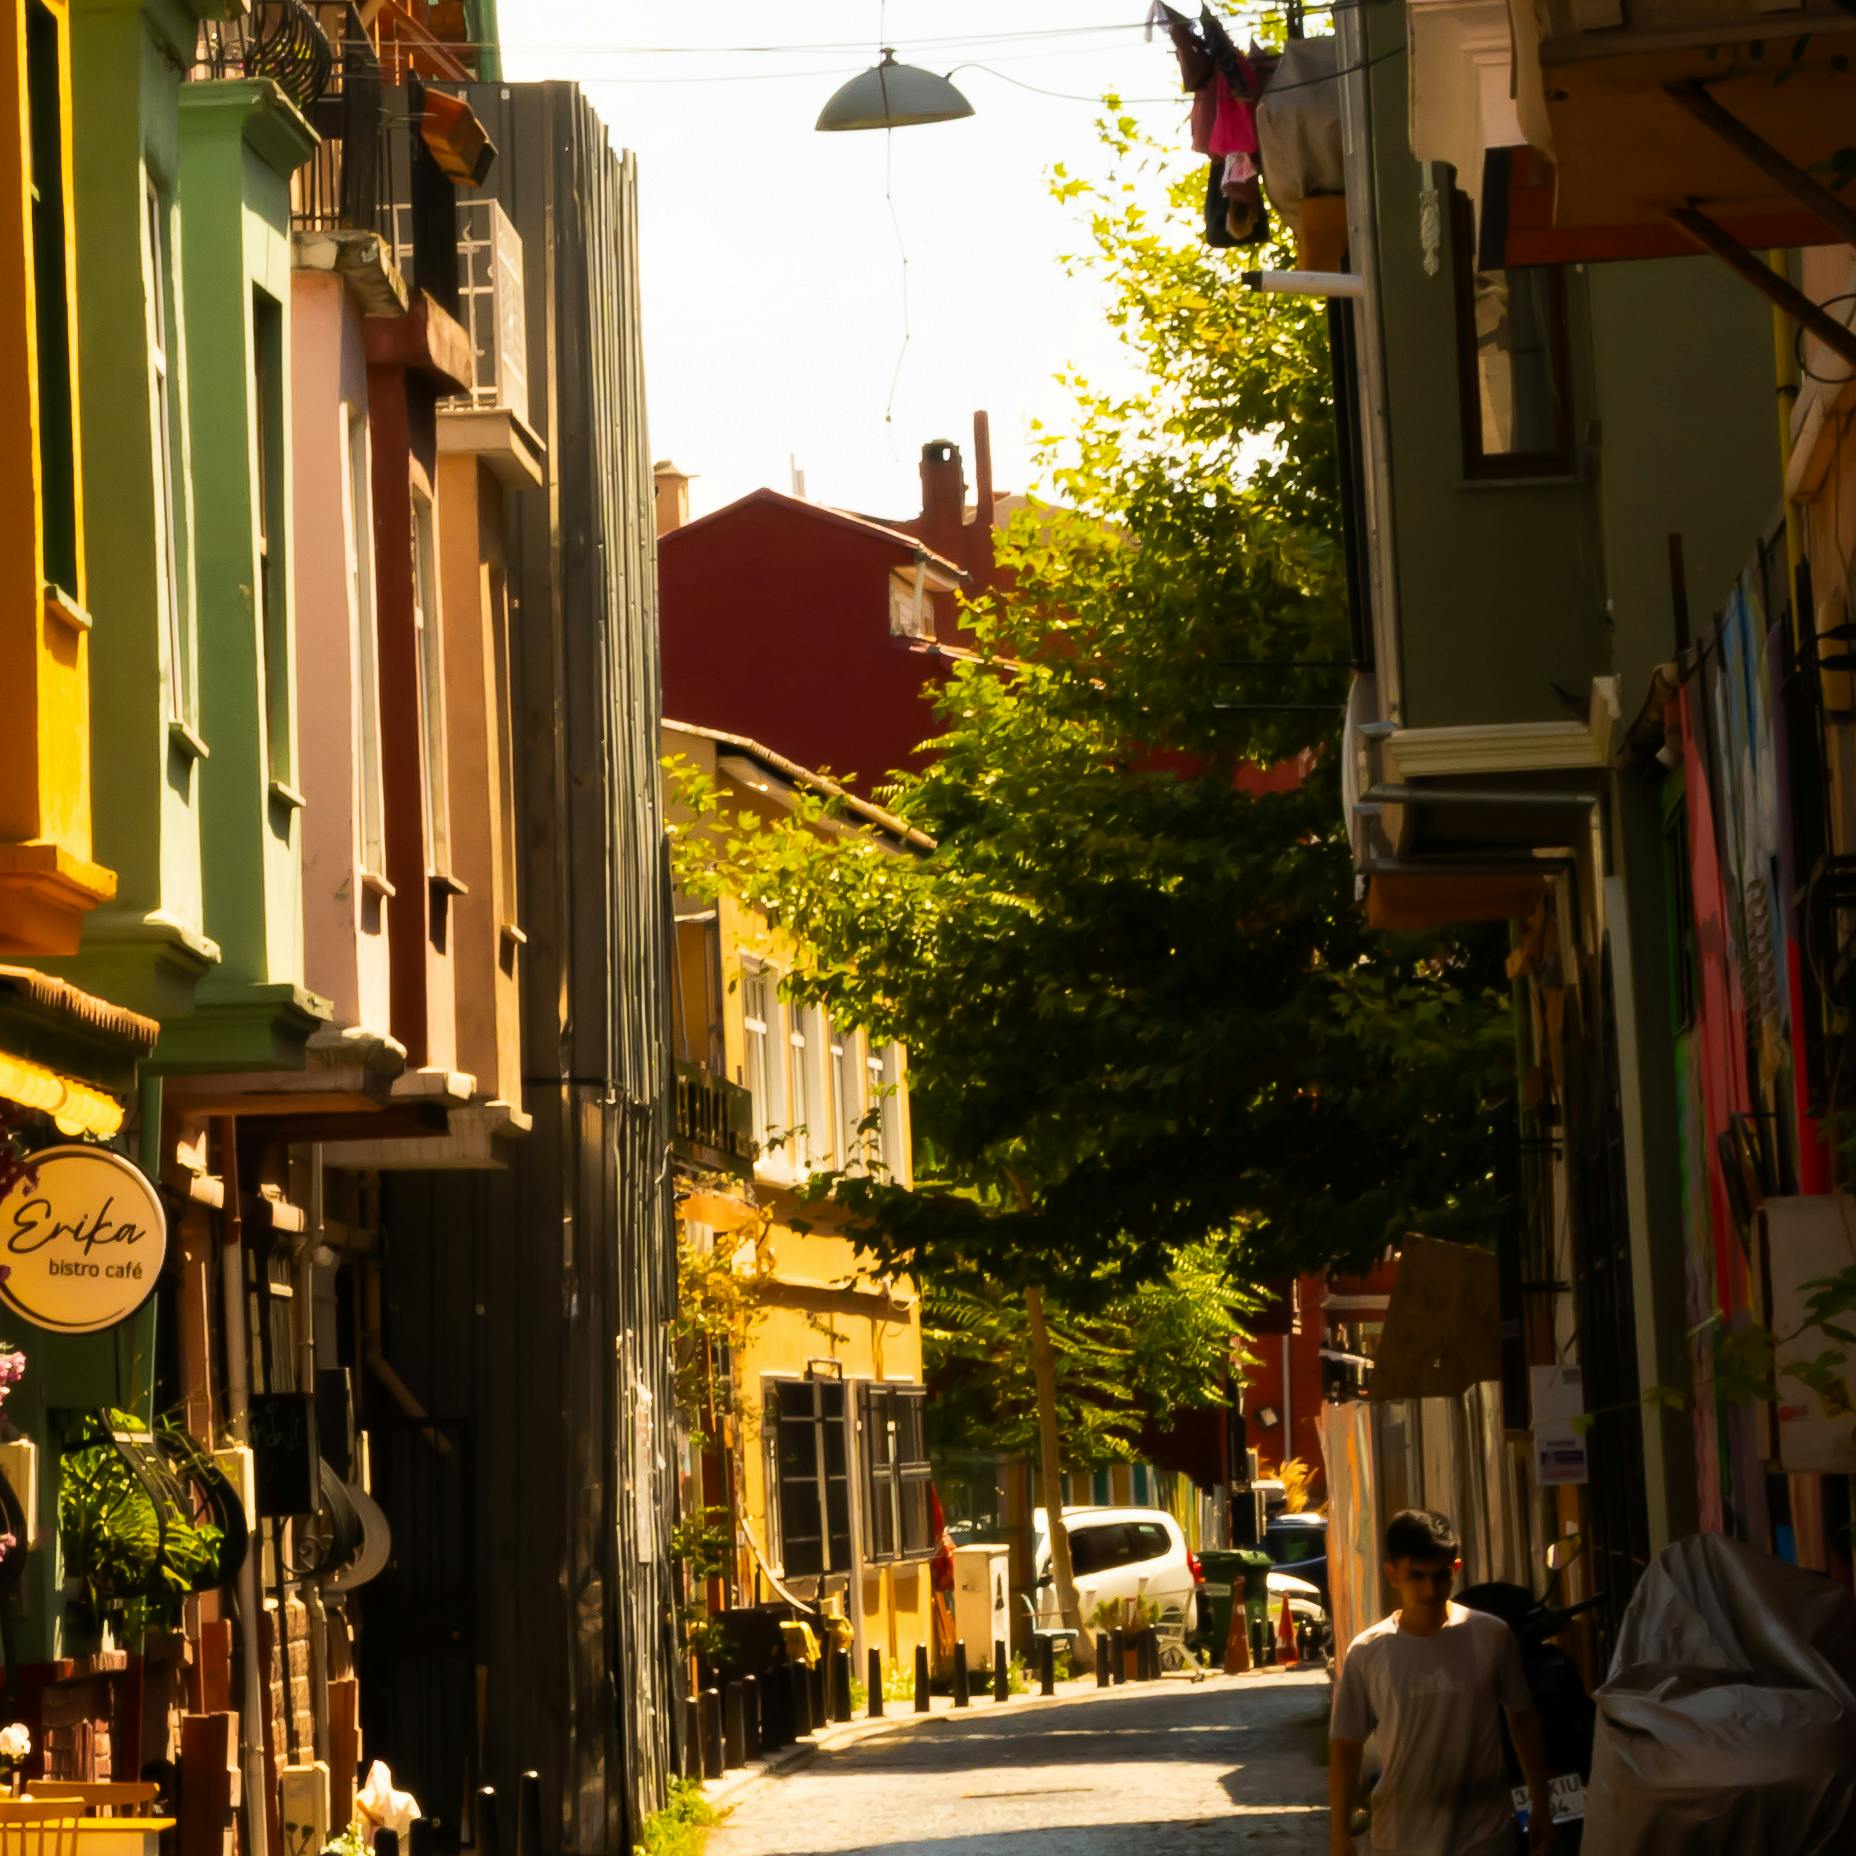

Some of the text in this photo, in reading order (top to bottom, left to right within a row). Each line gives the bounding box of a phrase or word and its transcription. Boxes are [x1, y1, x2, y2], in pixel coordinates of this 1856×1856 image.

[7, 1196, 146, 1256] Erika
[48, 1258, 143, 1280] bistro café
